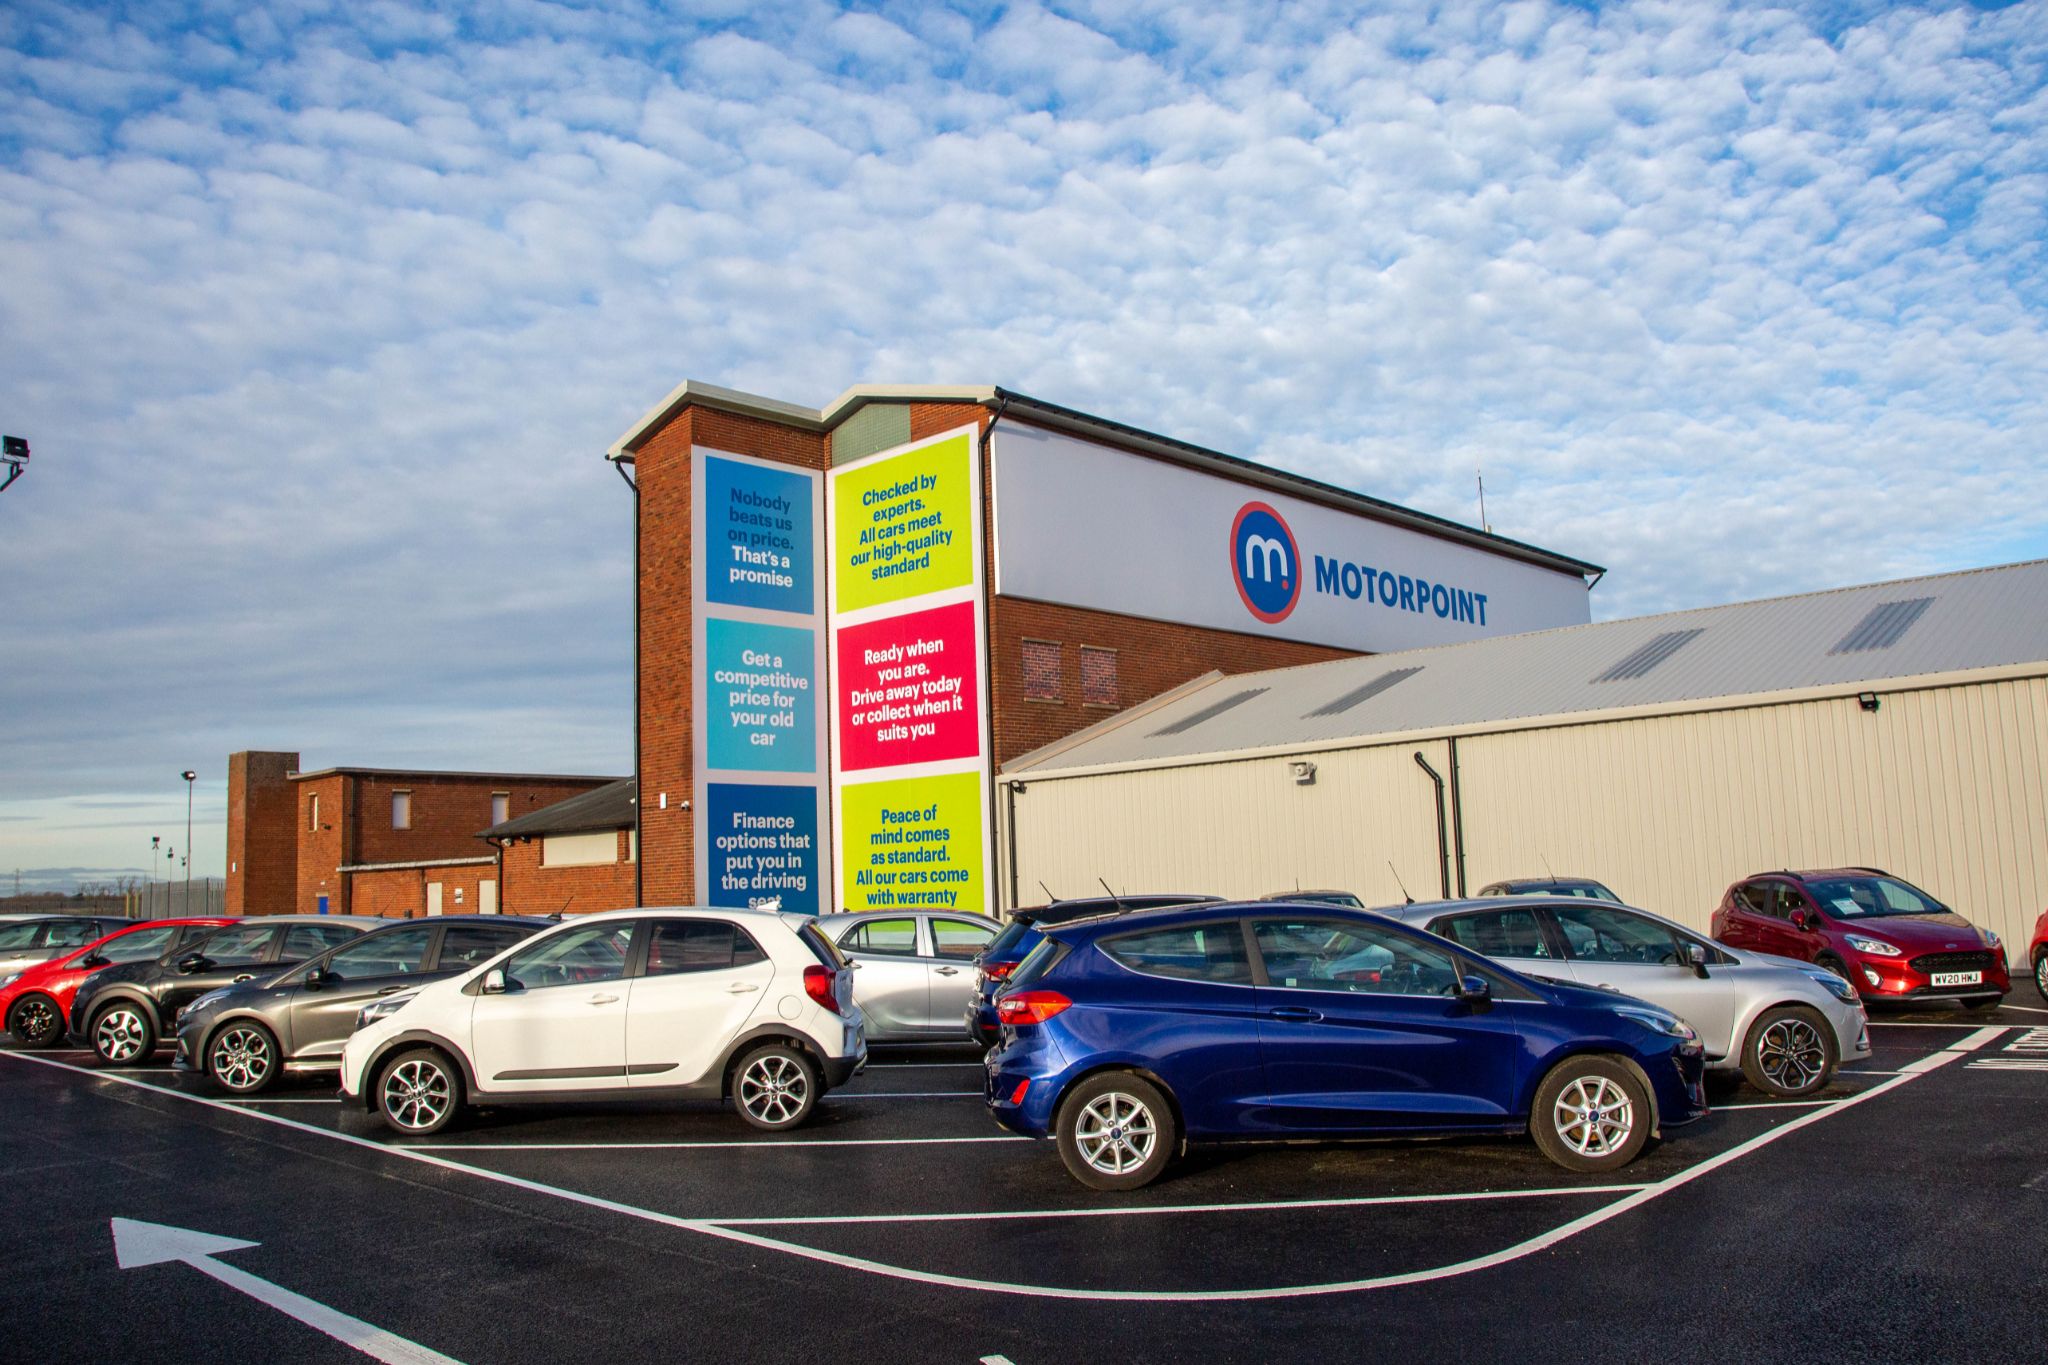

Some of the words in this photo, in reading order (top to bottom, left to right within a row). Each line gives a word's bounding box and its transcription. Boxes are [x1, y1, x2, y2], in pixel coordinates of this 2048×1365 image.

[862, 475, 918, 506] Checked
[920, 473, 938, 490] by
[730, 487, 791, 515] Nobody
[873, 498, 926, 521] experts.
[729, 506, 773, 528] beats
[775, 519, 793, 531] us
[859, 526, 876, 545] All
[878, 522, 906, 540] cars
[908, 511, 942, 532] meet
[727, 528, 748, 543] on
[751, 531, 794, 550] price.
[850, 550, 871, 567] our
[873, 529, 953, 561] high-quality
[732, 545, 779, 567] That's
[781, 556, 791, 568] a
[871, 551, 930, 581] standard
[729, 567, 793, 587] promise
[1314, 554, 1488, 626] MOTORPOINT
[742, 649, 771, 667] Get
[773, 656, 783, 668] a
[864, 643, 904, 665] Ready
[906, 638, 944, 657] when
[714, 670, 808, 689] competitive
[878, 667, 902, 686] you
[904, 662, 931, 678] are.
[729, 689, 771, 707] price
[773, 691, 795, 708] for
[851, 687, 885, 707] Drive
[886, 683, 921, 700] away
[922, 675, 962, 694] today
[731, 711, 767, 727] your
[769, 711, 794, 727] old
[851, 713, 865, 726] or
[866, 704, 911, 724] collect
[913, 698, 950, 717] when
[952, 694, 963, 711] it
[750, 733, 776, 746] car
[877, 723, 909, 742] suits
[910, 722, 935, 741] you
[733, 812, 795, 829] Finance
[881, 809, 921, 824] Peace
[923, 804, 937, 821] of
[716, 832, 777, 852] options
[779, 832, 811, 849] that
[870, 827, 903, 845] mind
[905, 828, 950, 843] comes
[726, 855, 754, 873] put
[756, 856, 785, 872] you
[787, 852, 802, 868] in
[871, 853, 885, 865] as
[887, 845, 951, 864] standard.
[721, 873, 749, 890] the
[751, 872, 807, 891] driving
[856, 869, 873, 885] All
[875, 872, 897, 885] our
[899, 871, 928, 884] cars
[930, 869, 969, 883] come
[867, 888, 895, 905] with
[897, 889, 958, 907] warranty
[1934, 974, 1959, 984] WV20
[1961, 973, 1978, 983] HWJ
